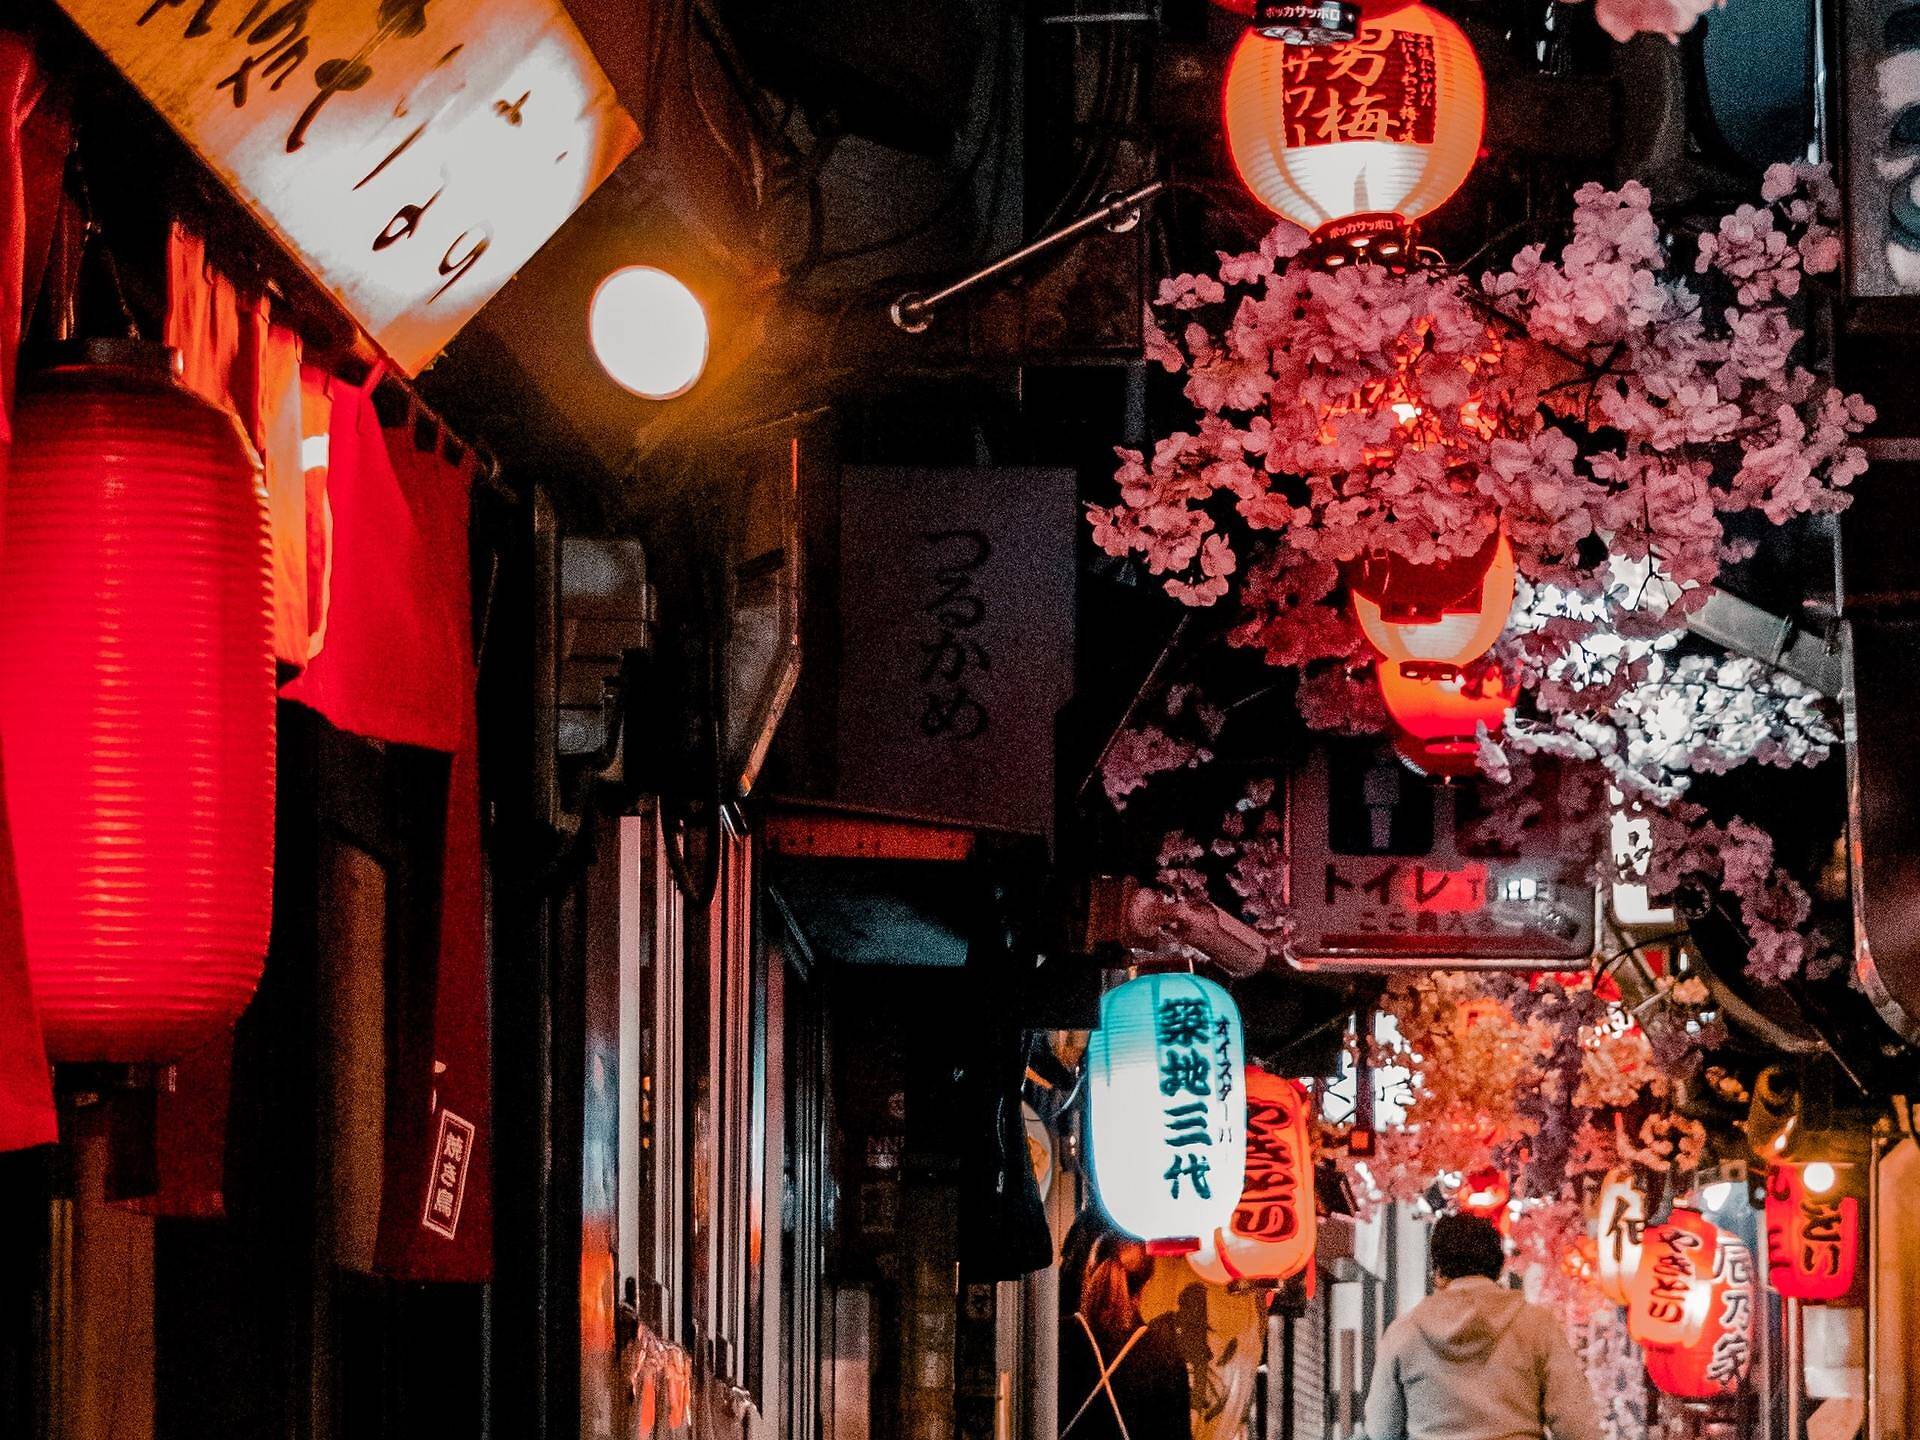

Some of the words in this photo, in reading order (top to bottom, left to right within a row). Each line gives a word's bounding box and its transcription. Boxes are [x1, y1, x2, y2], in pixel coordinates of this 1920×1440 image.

[1282, 48, 1322, 147] サワー
[1312, 28, 1400, 143] 男梅
[921, 529, 991, 741] つるかめ
[1325, 863, 1450, 905] トイレ
[1159, 998, 1212, 1200] 築地三代
